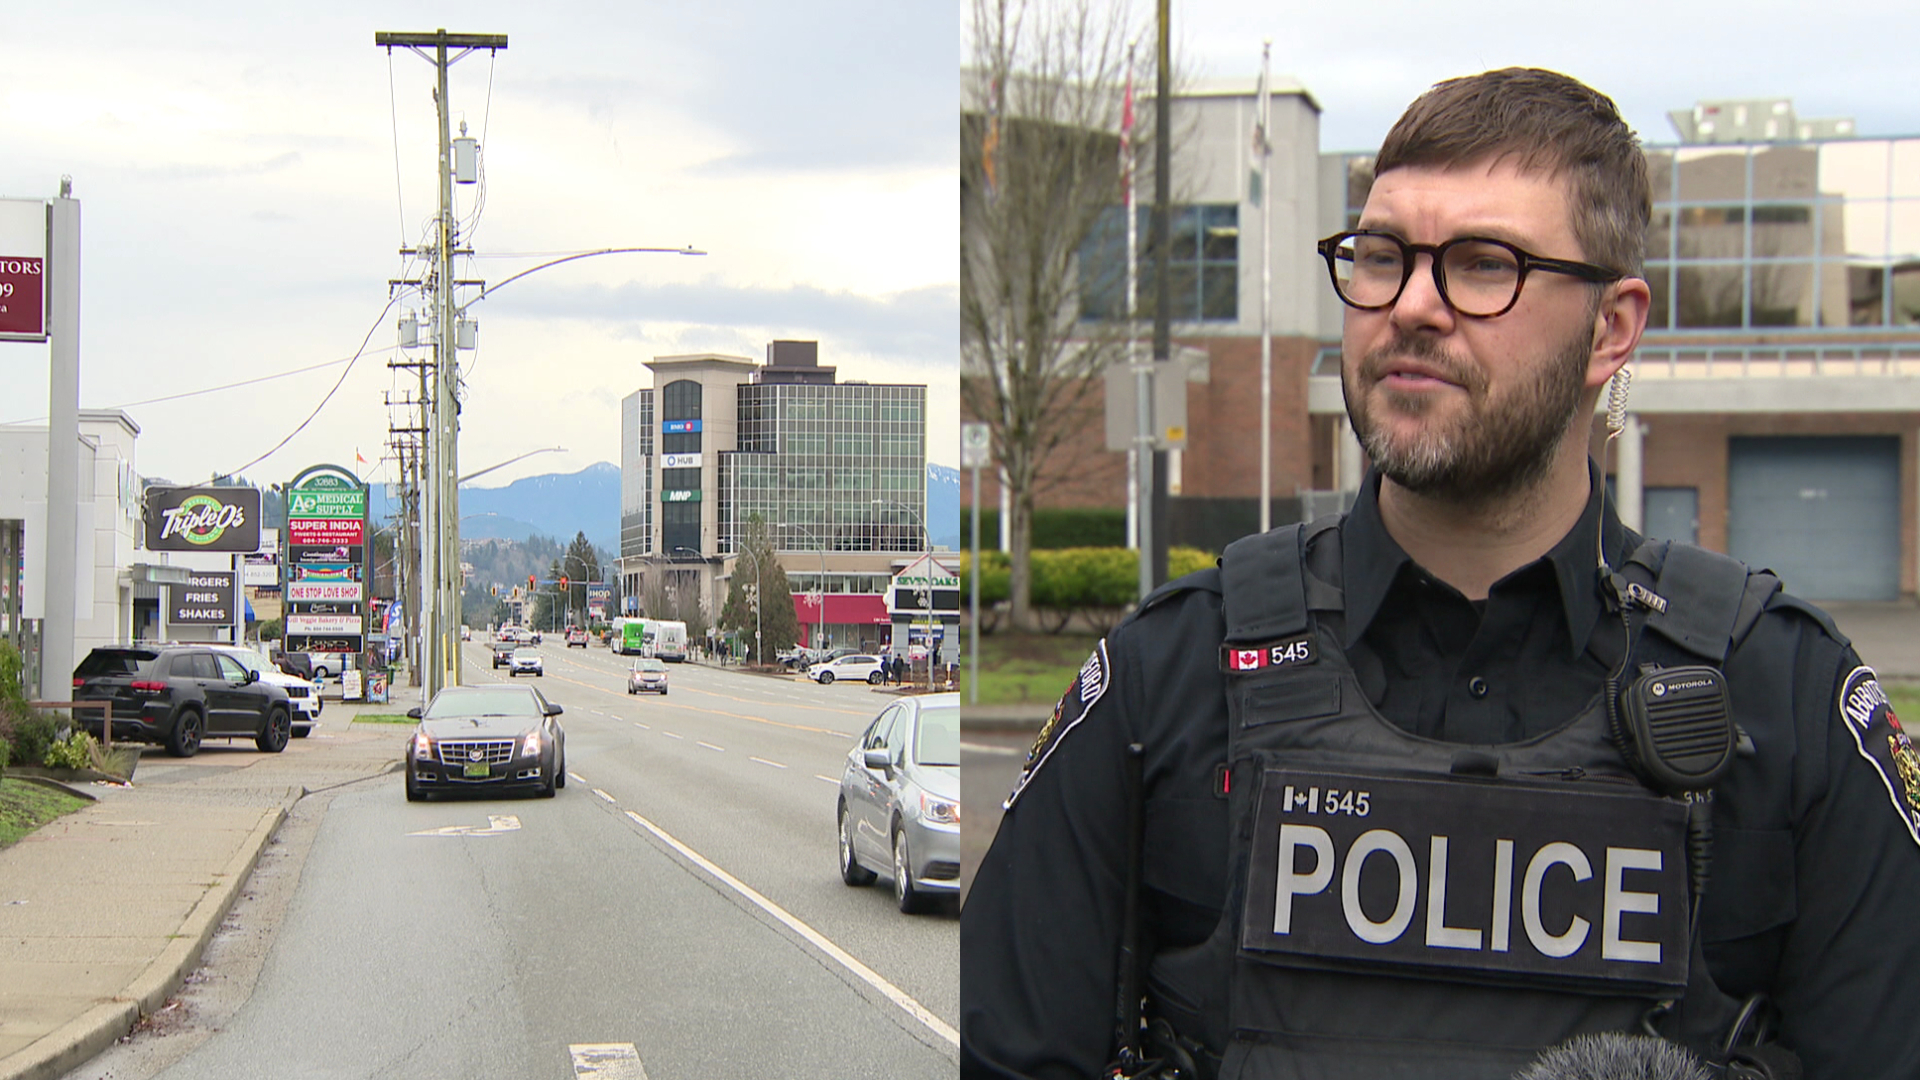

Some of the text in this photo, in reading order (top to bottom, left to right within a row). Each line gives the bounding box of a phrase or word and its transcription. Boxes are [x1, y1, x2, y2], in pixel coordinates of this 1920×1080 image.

[678, 457, 693, 465] HUB
[316, 494, 362, 504] MEDICAL
[669, 490, 691, 501] MNP
[316, 505, 354, 514] SUPPLY
[290, 521, 361, 530] SUPER INDIA
[931, 577, 958, 585] OAKS
[291, 587, 304, 598] ONE
[305, 587, 321, 598] STOP
[323, 587, 339, 598] LOVE
[341, 587, 357, 598] SHOP
[185, 593, 219, 603] FRIES
[179, 609, 225, 619] SHAKES
[301, 616, 318, 625] Veggie
[319, 616, 338, 625] Bakery
[345, 616, 360, 624] Pizza
[1271, 641, 1309, 666] 545
[1668, 679, 1713, 691] MOTOROLA
[1324, 789, 1371, 817] 545
[1273, 823, 1664, 965] POLICE
